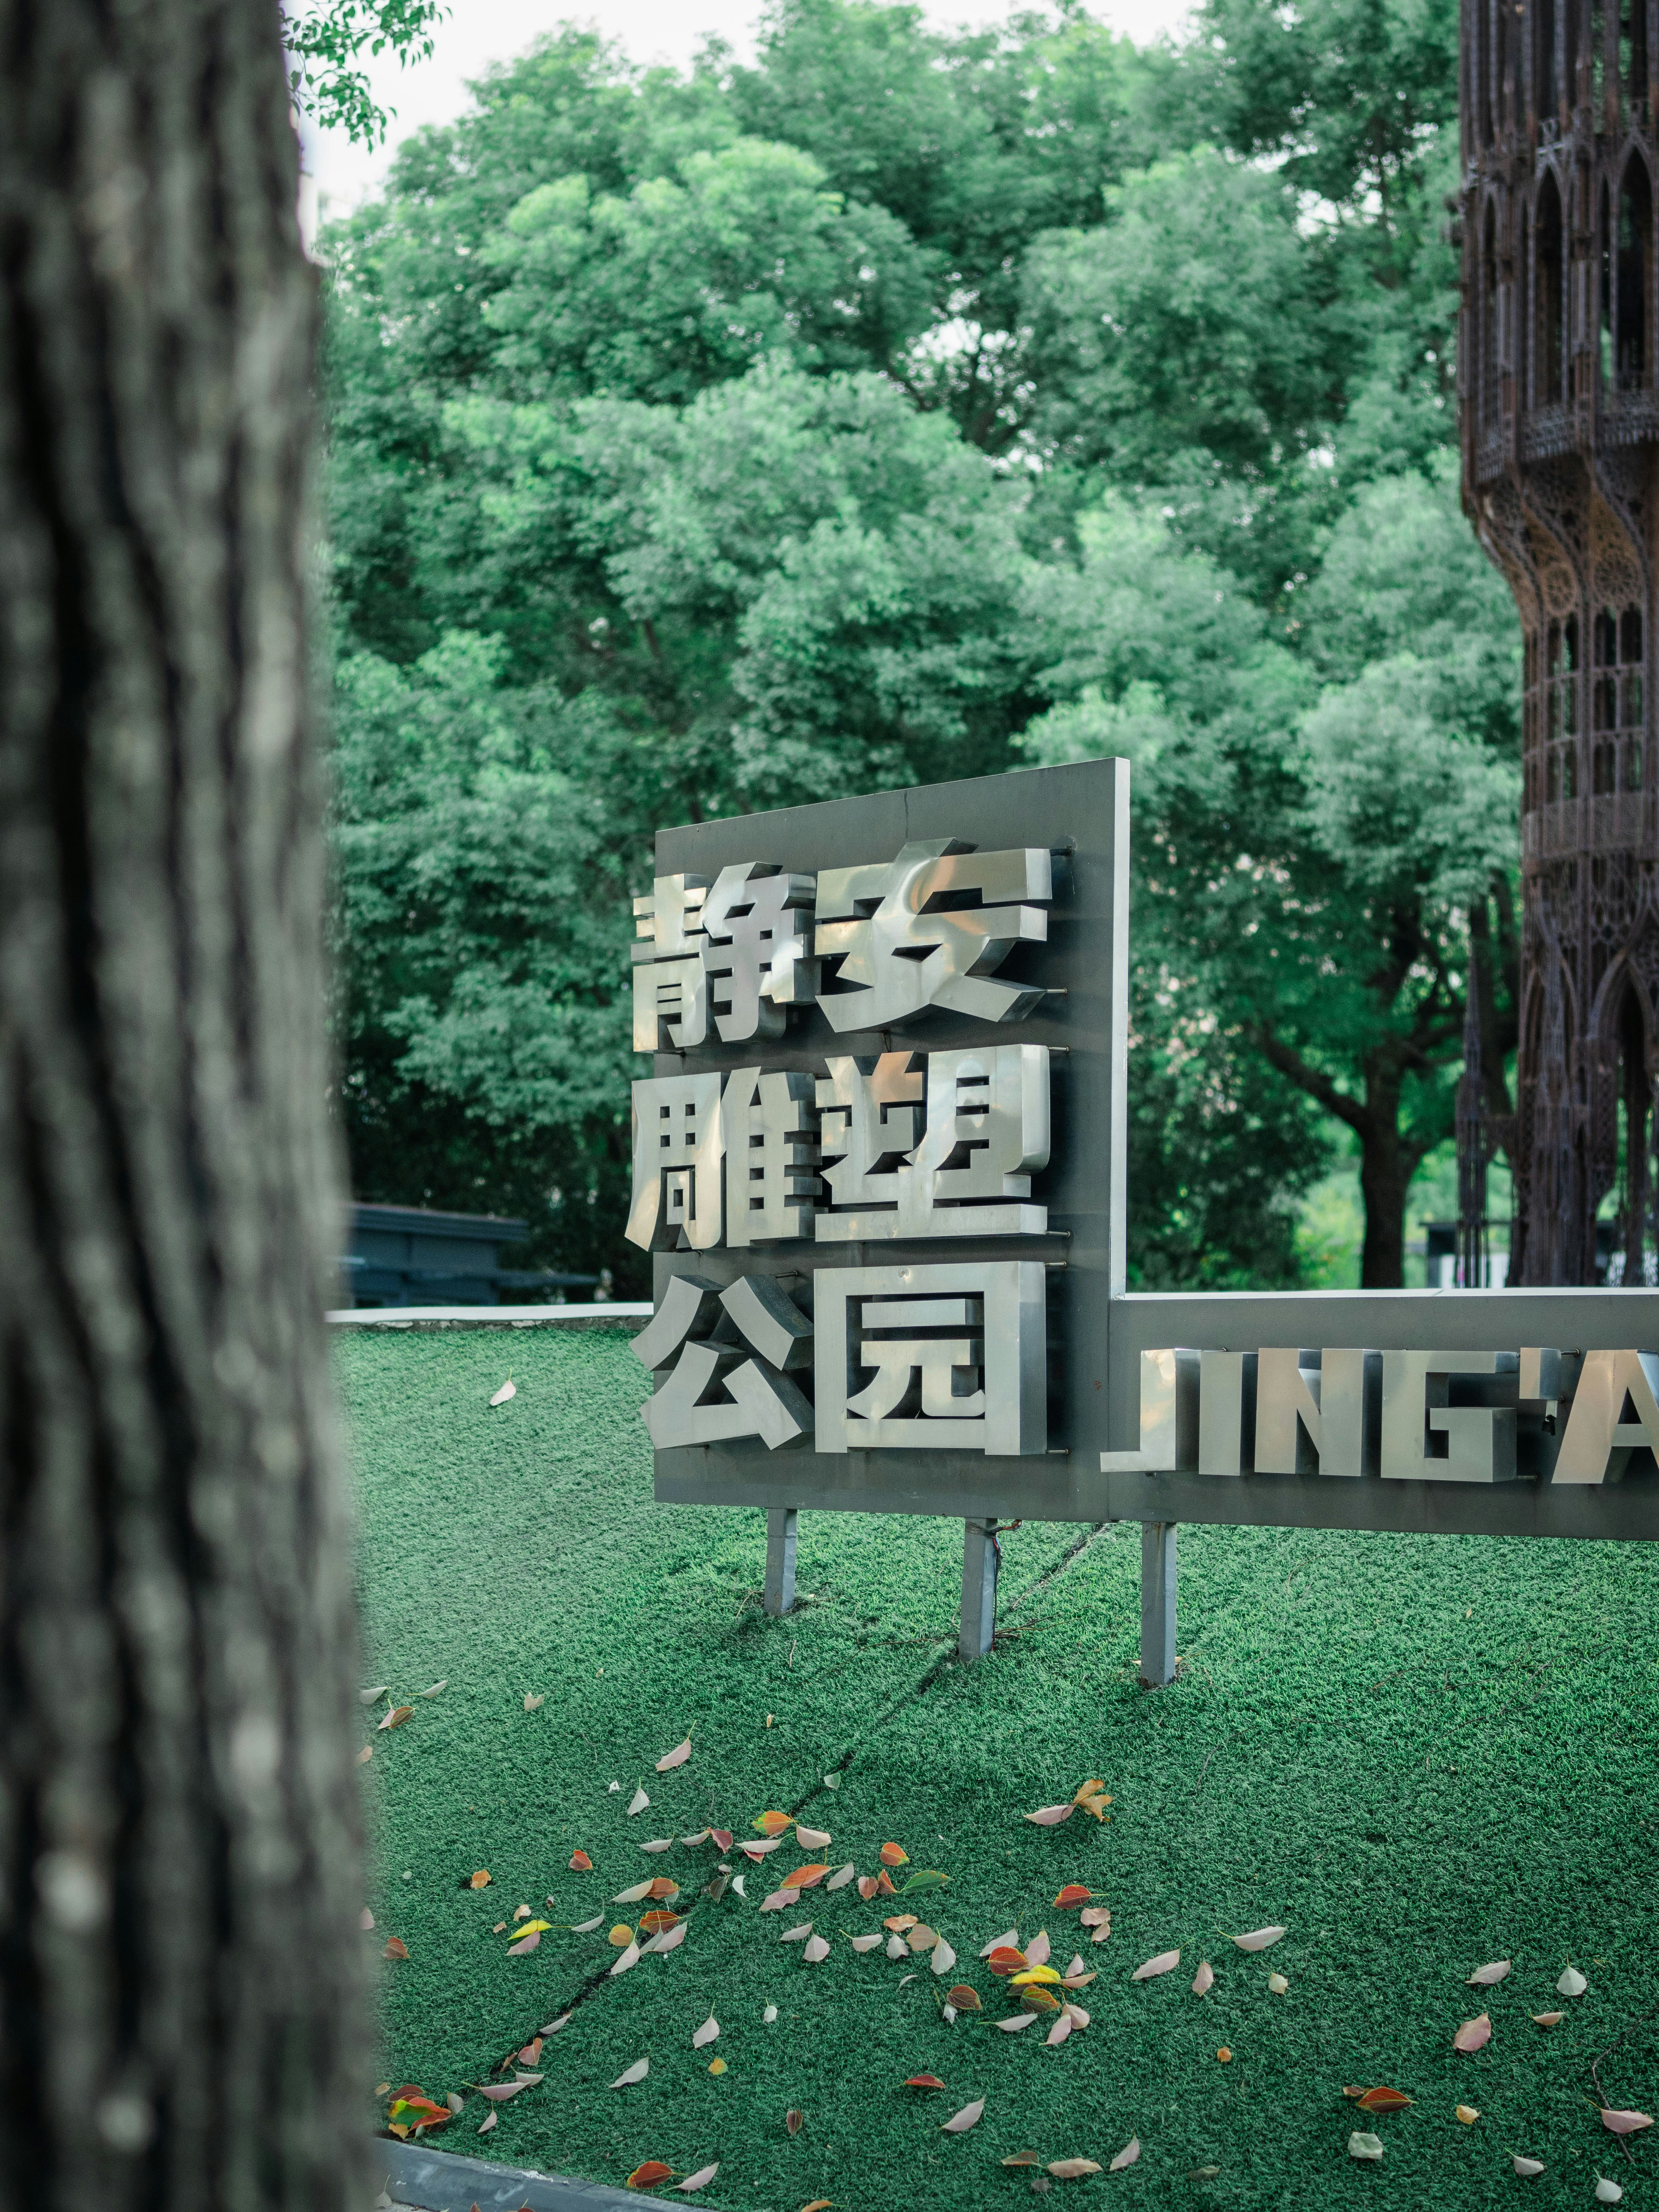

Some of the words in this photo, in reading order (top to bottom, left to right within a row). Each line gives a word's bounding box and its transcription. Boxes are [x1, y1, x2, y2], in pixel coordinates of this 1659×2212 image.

[631, 838, 1052, 1053] 静安
[625, 1044, 1050, 1251] 雕塑
[629, 1261, 1046, 1455] 公园
